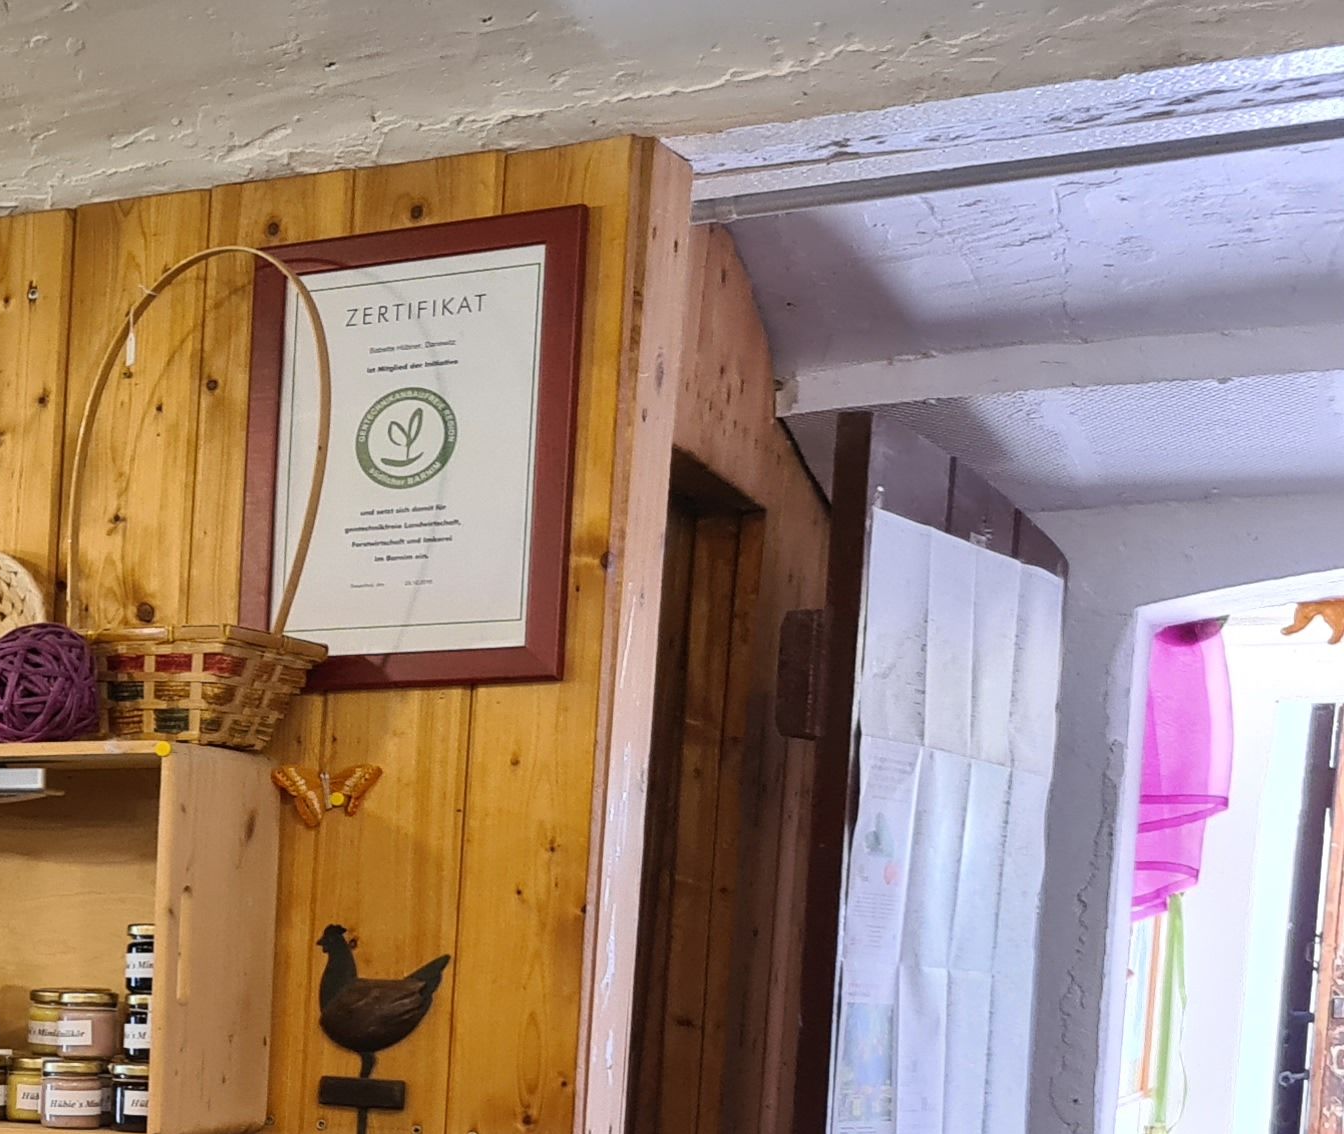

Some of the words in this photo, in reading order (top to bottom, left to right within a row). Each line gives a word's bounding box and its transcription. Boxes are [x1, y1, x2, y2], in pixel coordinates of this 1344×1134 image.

[345, 293, 487, 327] ZERTIFIKAT
[377, 363, 408, 373] Mitglied
[424, 358, 459, 368] Initiative
[351, 538, 405, 547] Forstwirtschaft
